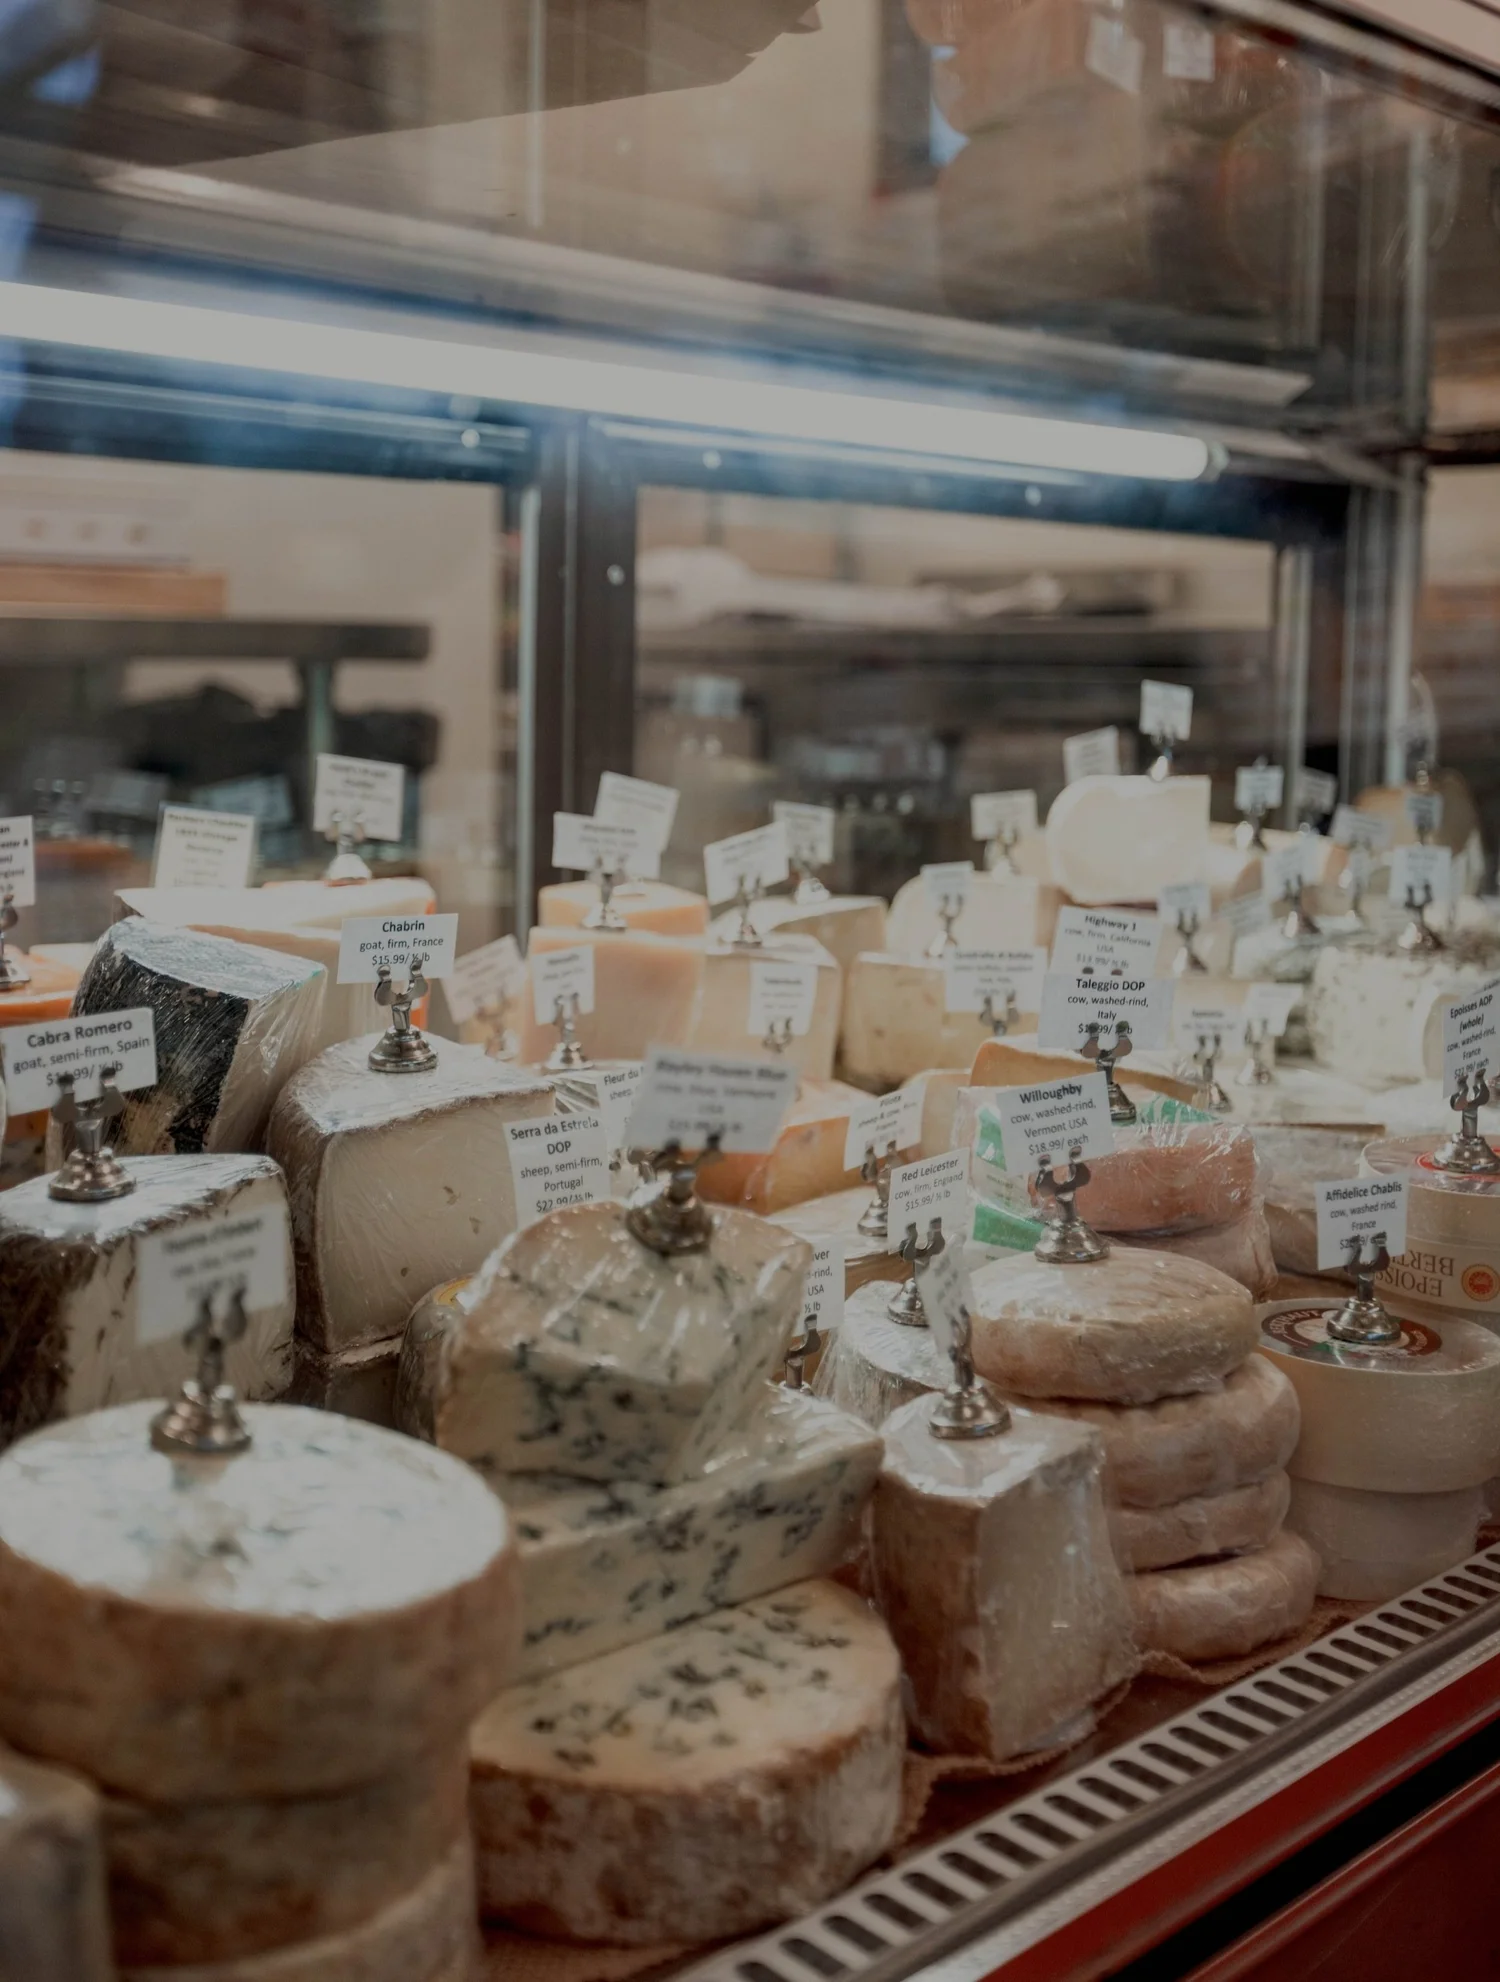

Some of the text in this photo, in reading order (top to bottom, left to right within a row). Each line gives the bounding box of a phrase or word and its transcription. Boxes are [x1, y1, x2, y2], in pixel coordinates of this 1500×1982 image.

[382, 920, 425, 932] Chabrin
[1085, 915, 1128, 930] Highway
[360, 937, 444, 952] goat, firm, France
[1076, 978, 1145, 992] Taleggio DOP
[1067, 995, 1149, 1008] cow, washed-rind,
[1449, 994, 1493, 1019] Epoisses AOP
[1097, 1010, 1117, 1021] Italy
[1459, 1013, 1484, 1034] (whole)
[27, 1020, 132, 1048] Cabra Romero
[13, 1037, 150, 1074] goat, semi-firm, Spain
[1462, 1047, 1481, 1061] France
[603, 1070, 639, 1086] Fleur du
[1019, 1083, 1082, 1104] Willoughby
[1010, 1099, 1096, 1124] cow, washed-rind,
[510, 1117, 599, 1140] Serra da Estrela
[1024, 1117, 1088, 1138] Vermont USA
[546, 1140, 572, 1155] DOP
[1067, 1134, 1089, 1147] each
[520, 1156, 603, 1179] sheep, semi-firm,
[901, 1159, 959, 1183] Red Leicester
[544, 1176, 584, 1192] Portugal
[933, 1170, 964, 1188] England
[1325, 1181, 1402, 1202] Affidelice Chablis
[1330, 1200, 1397, 1219] cow, washed rind,
[1351, 1220, 1376, 1231] France
[807, 1284, 825, 1296] USA
[813, 1301, 821, 1311] lb
